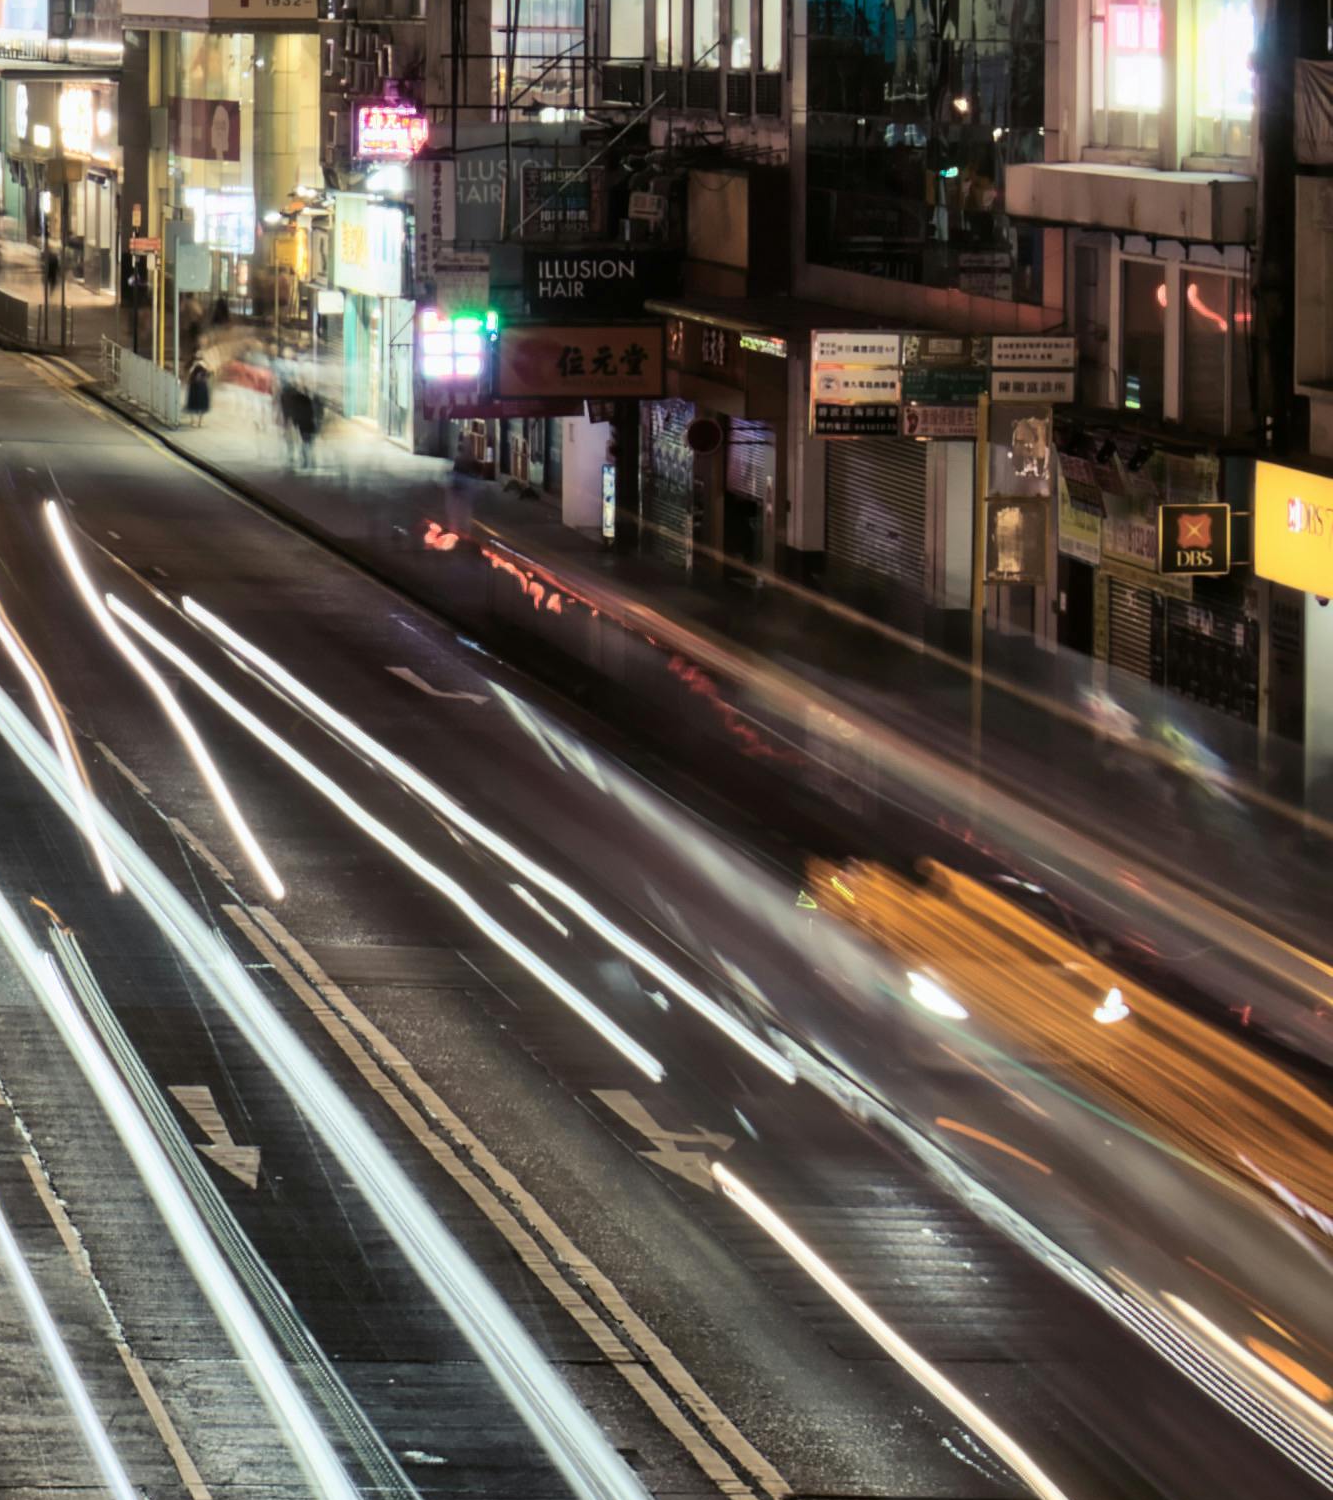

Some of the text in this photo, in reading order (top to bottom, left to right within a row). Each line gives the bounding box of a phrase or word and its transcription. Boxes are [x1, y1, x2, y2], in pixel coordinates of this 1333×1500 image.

[538, 260, 635, 279] ILLUSION
[539, 281, 584, 298] HAIR
[556, 343, 649, 377] 位元堂
[1176, 551, 1213, 567] DBS
